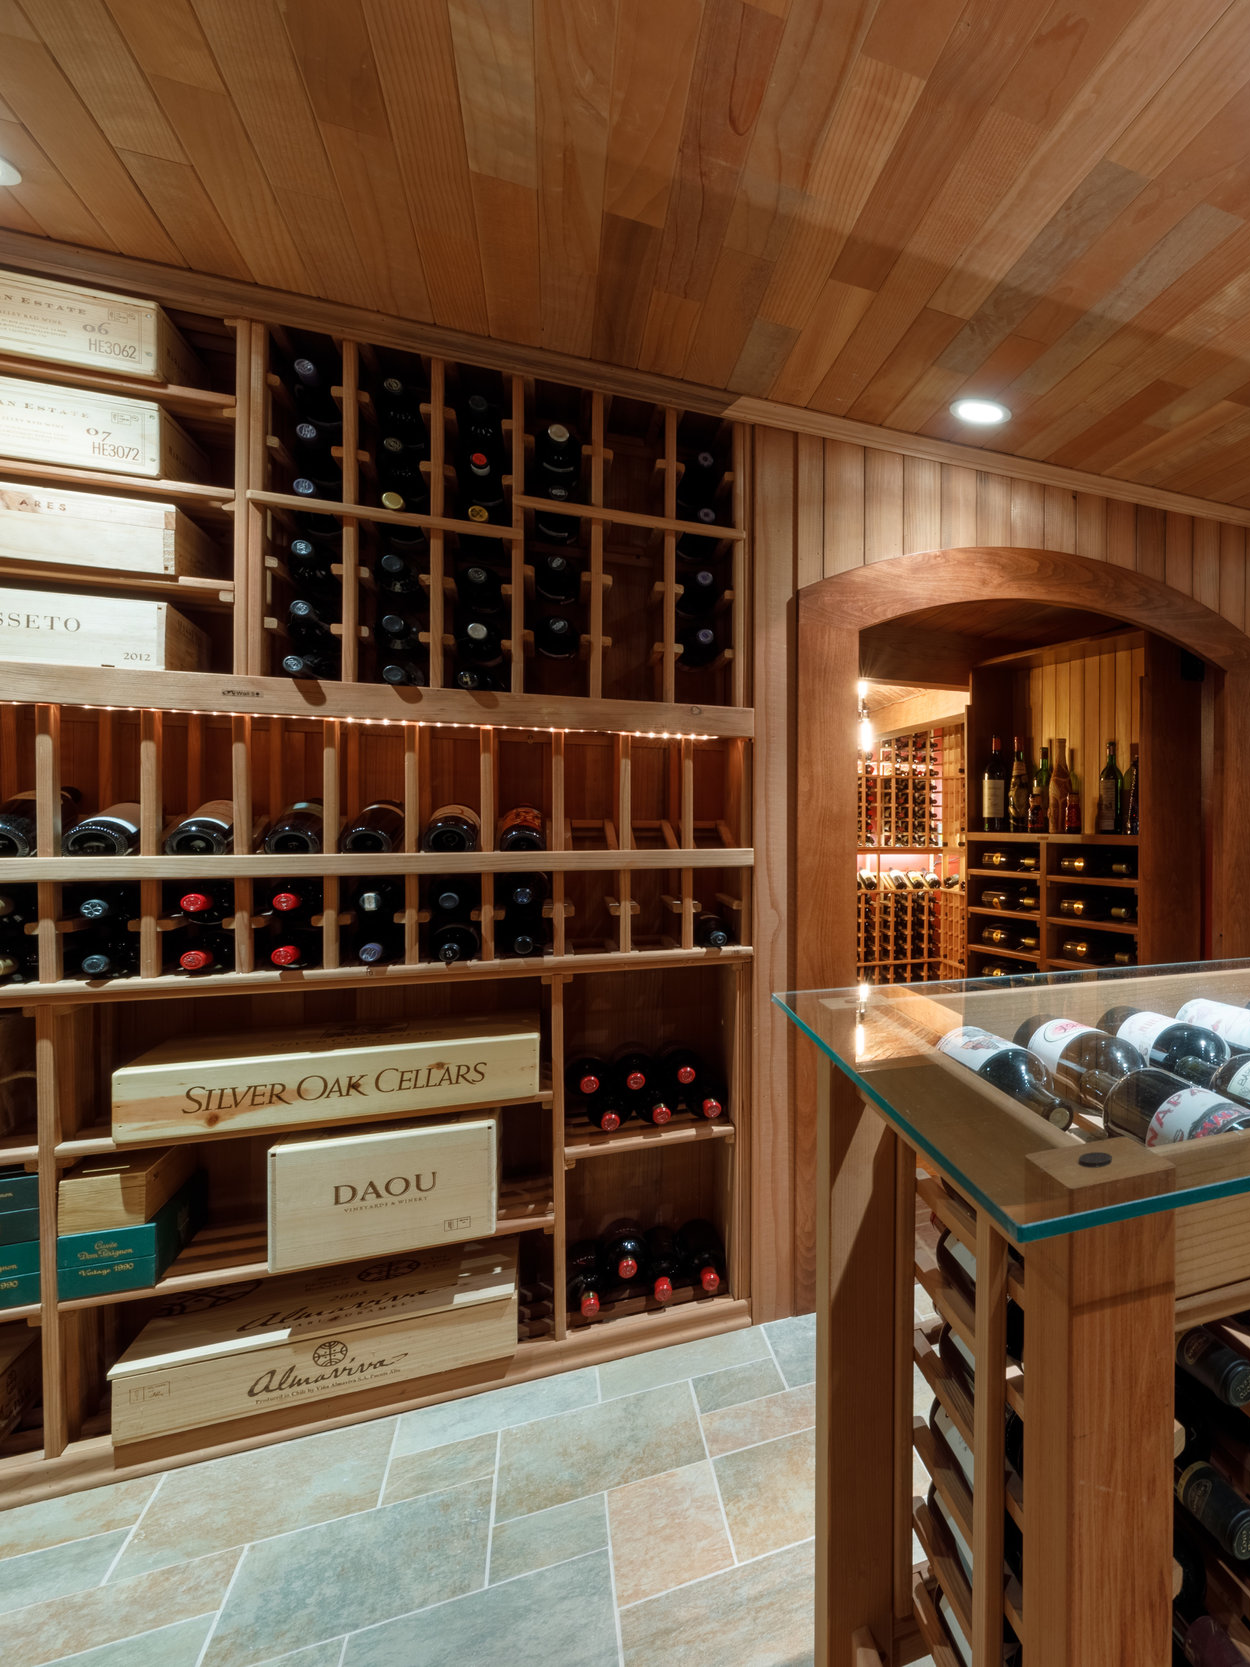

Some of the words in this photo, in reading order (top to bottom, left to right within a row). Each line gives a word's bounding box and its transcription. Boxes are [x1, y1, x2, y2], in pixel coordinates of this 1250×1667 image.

[21, 297, 86, 315] ESTATE
[88, 338, 137, 359] HE3062
[24, 403, 89, 418] ESTATE
[92, 441, 140, 461] HE3072
[19, 499, 66, 511] ARES
[123, 652, 151, 662] 2012
[182, 1082, 293, 1114] SILVER
[296, 1074, 368, 1101] OAK
[374, 1061, 487, 1093] CELLARS
[333, 1172, 437, 1206] DAOU
[344, 1203, 388, 1213] VINEYARDS
[398, 1196, 428, 1205] WINERY
[78, 1268, 111, 1277] Vintage
[113, 1263, 134, 1272] 1990
[247, 1353, 409, 1398] Almaviva
